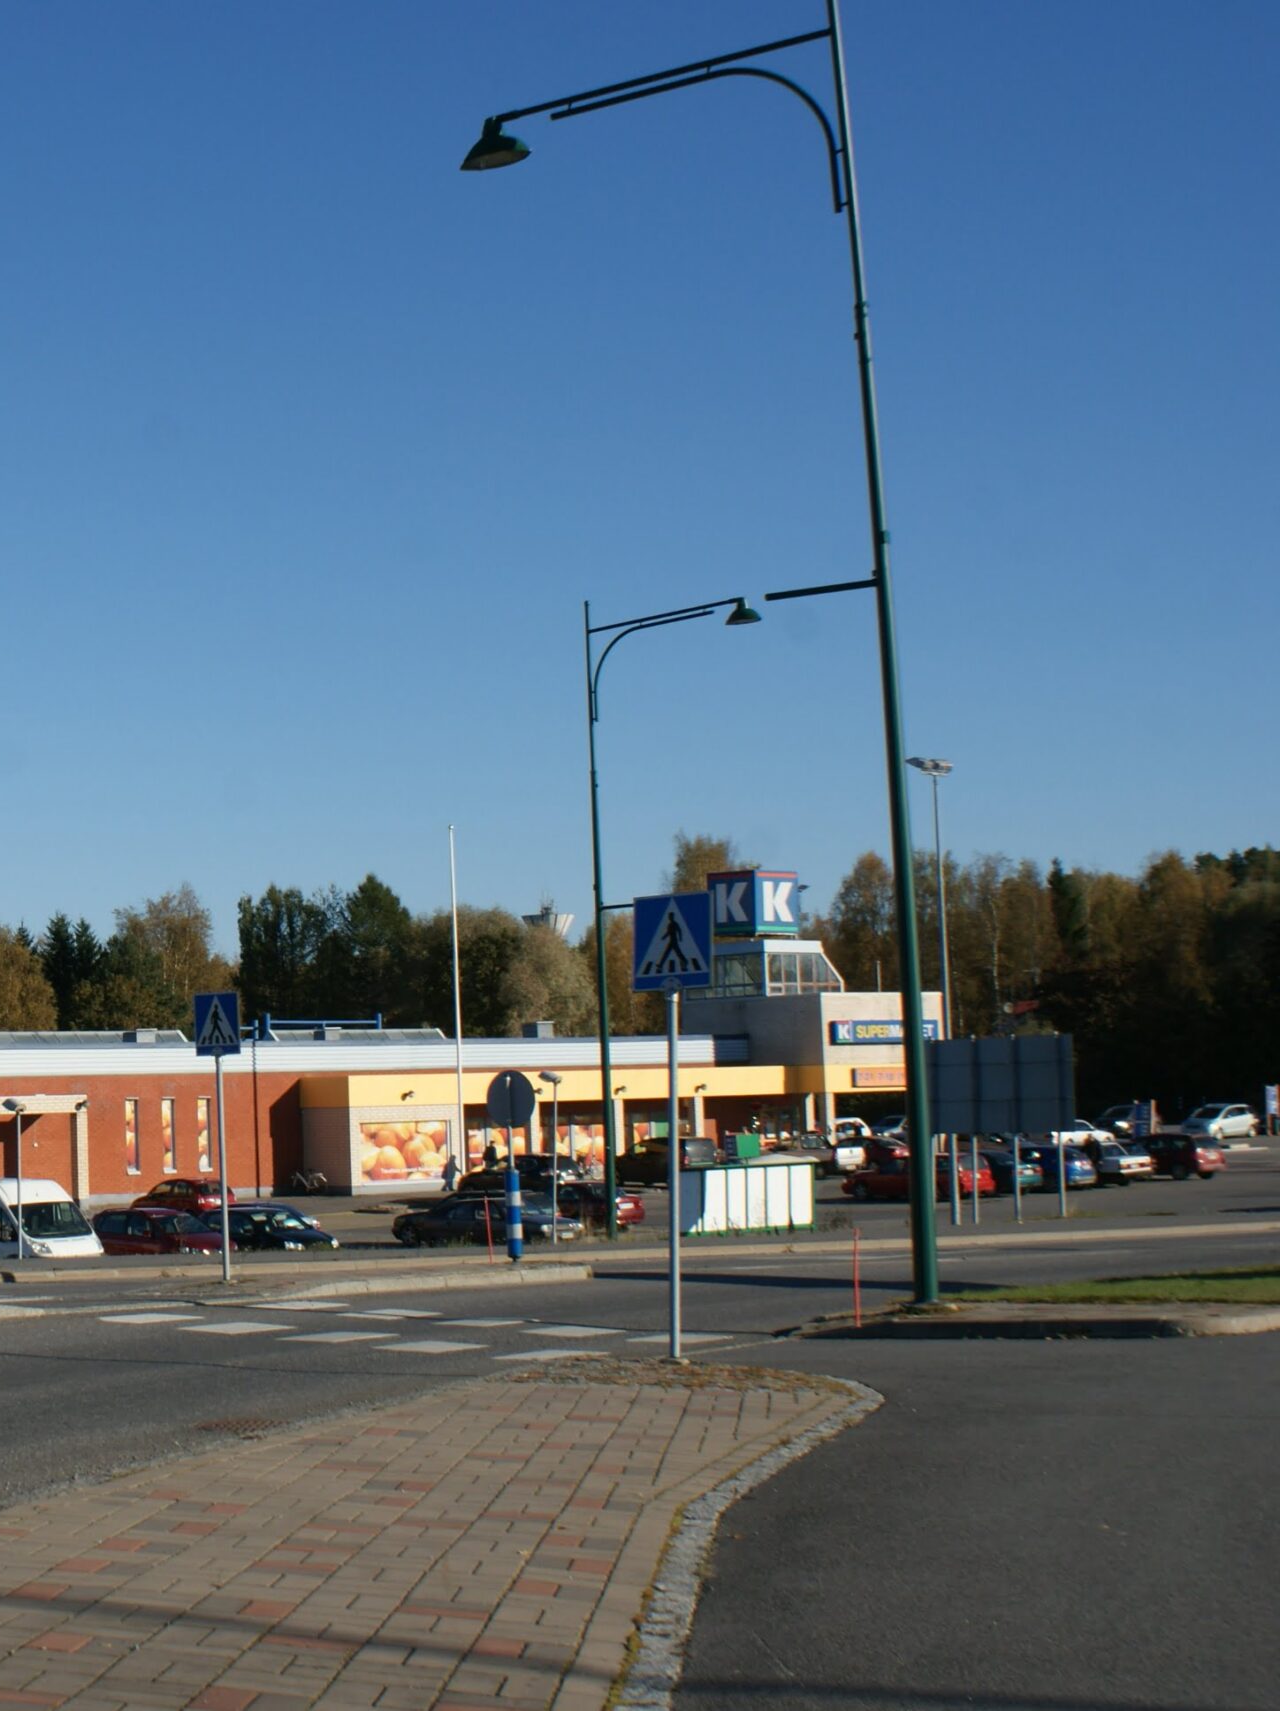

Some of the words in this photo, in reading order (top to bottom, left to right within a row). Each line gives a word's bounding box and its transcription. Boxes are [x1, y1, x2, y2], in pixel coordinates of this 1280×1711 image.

[715, 881, 749, 923] K
[762, 880, 794, 922] K
[838, 1023, 850, 1040] K
